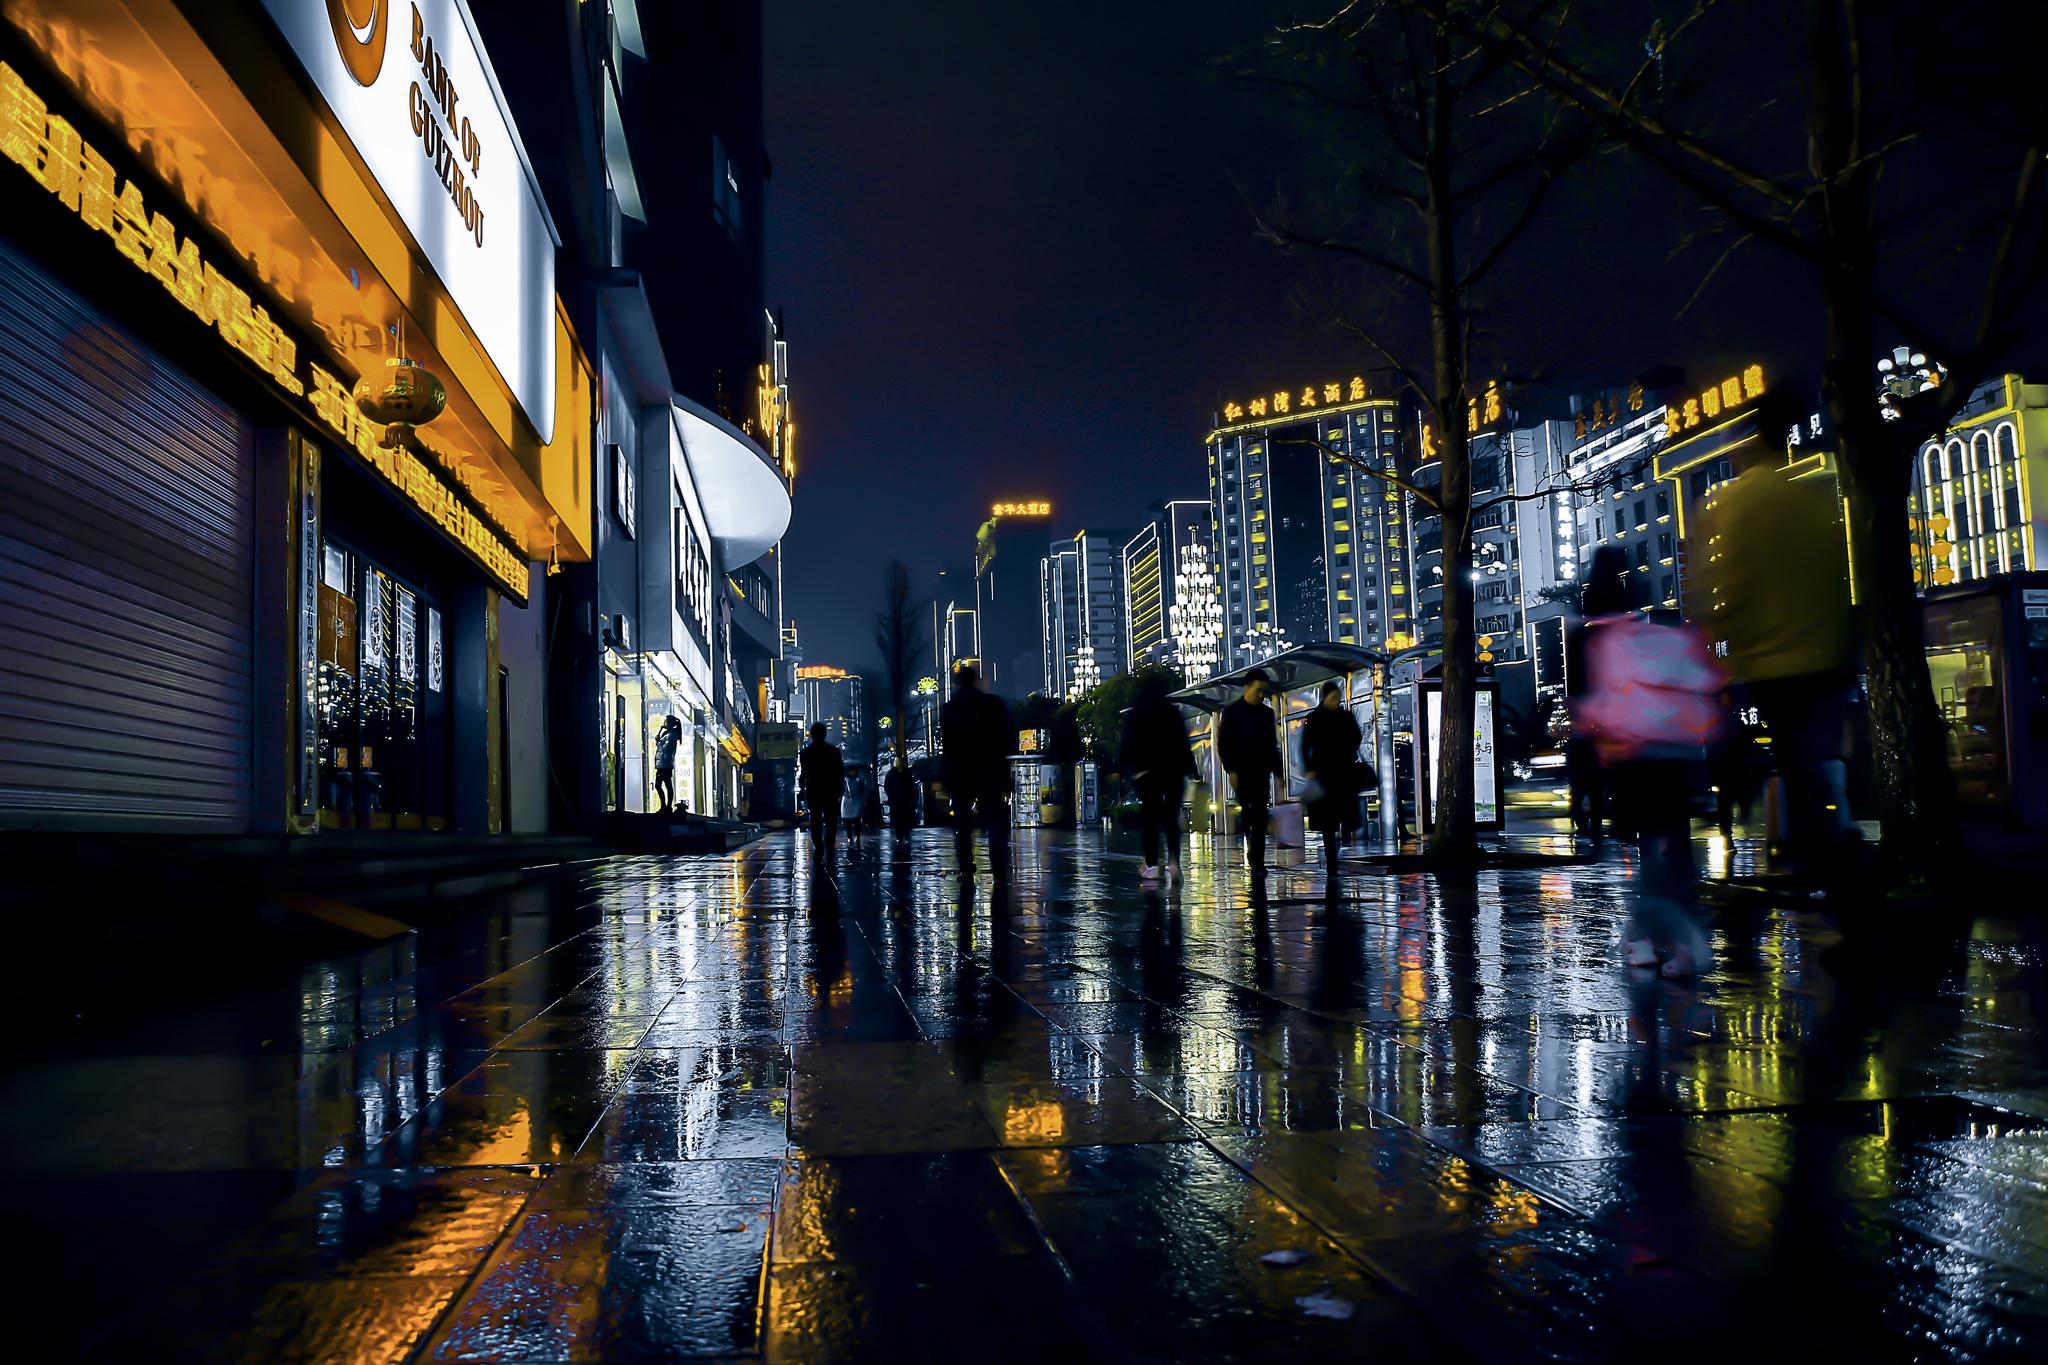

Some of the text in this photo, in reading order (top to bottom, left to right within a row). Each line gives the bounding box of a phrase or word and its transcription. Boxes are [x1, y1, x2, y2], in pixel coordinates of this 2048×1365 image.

[409, 80, 485, 249] GUIZHOU
[410, 1, 481, 180] BANK OF
[1223, 375, 1366, 423] 红树湾大酒店
